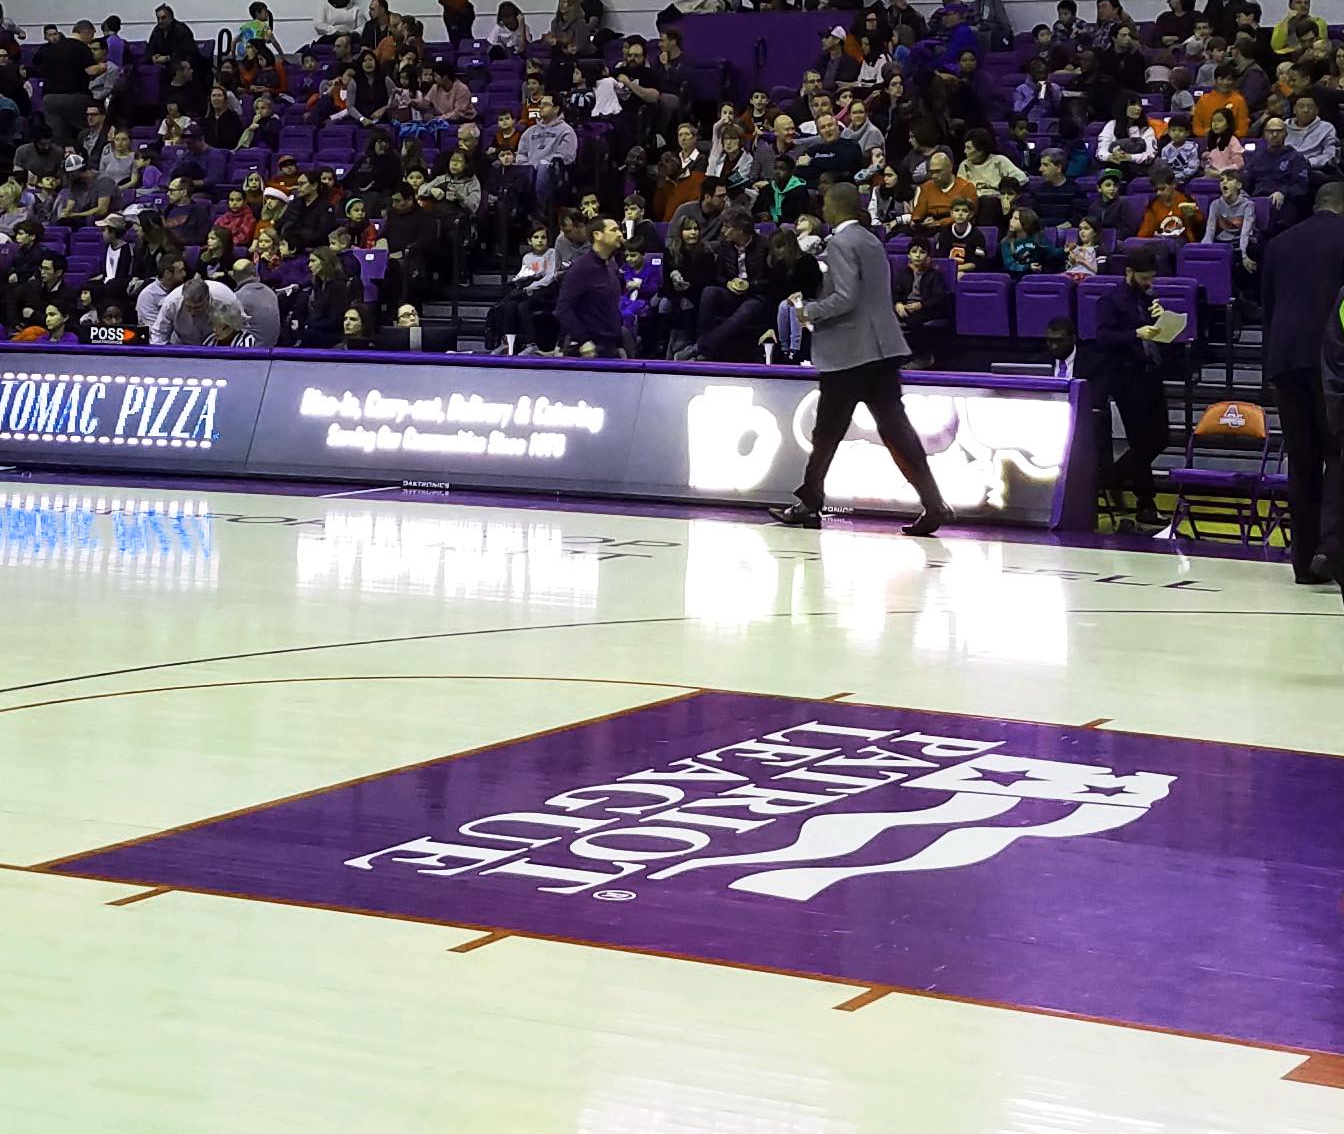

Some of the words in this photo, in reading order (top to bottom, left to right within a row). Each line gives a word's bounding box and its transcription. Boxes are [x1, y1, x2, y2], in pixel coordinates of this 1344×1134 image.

[89, 326, 125, 342] POSS
[114, 385, 218, 439] PIZZA
[343, 721, 901, 875] LEAGUE
[479, 731, 1007, 894] PATRIOT
